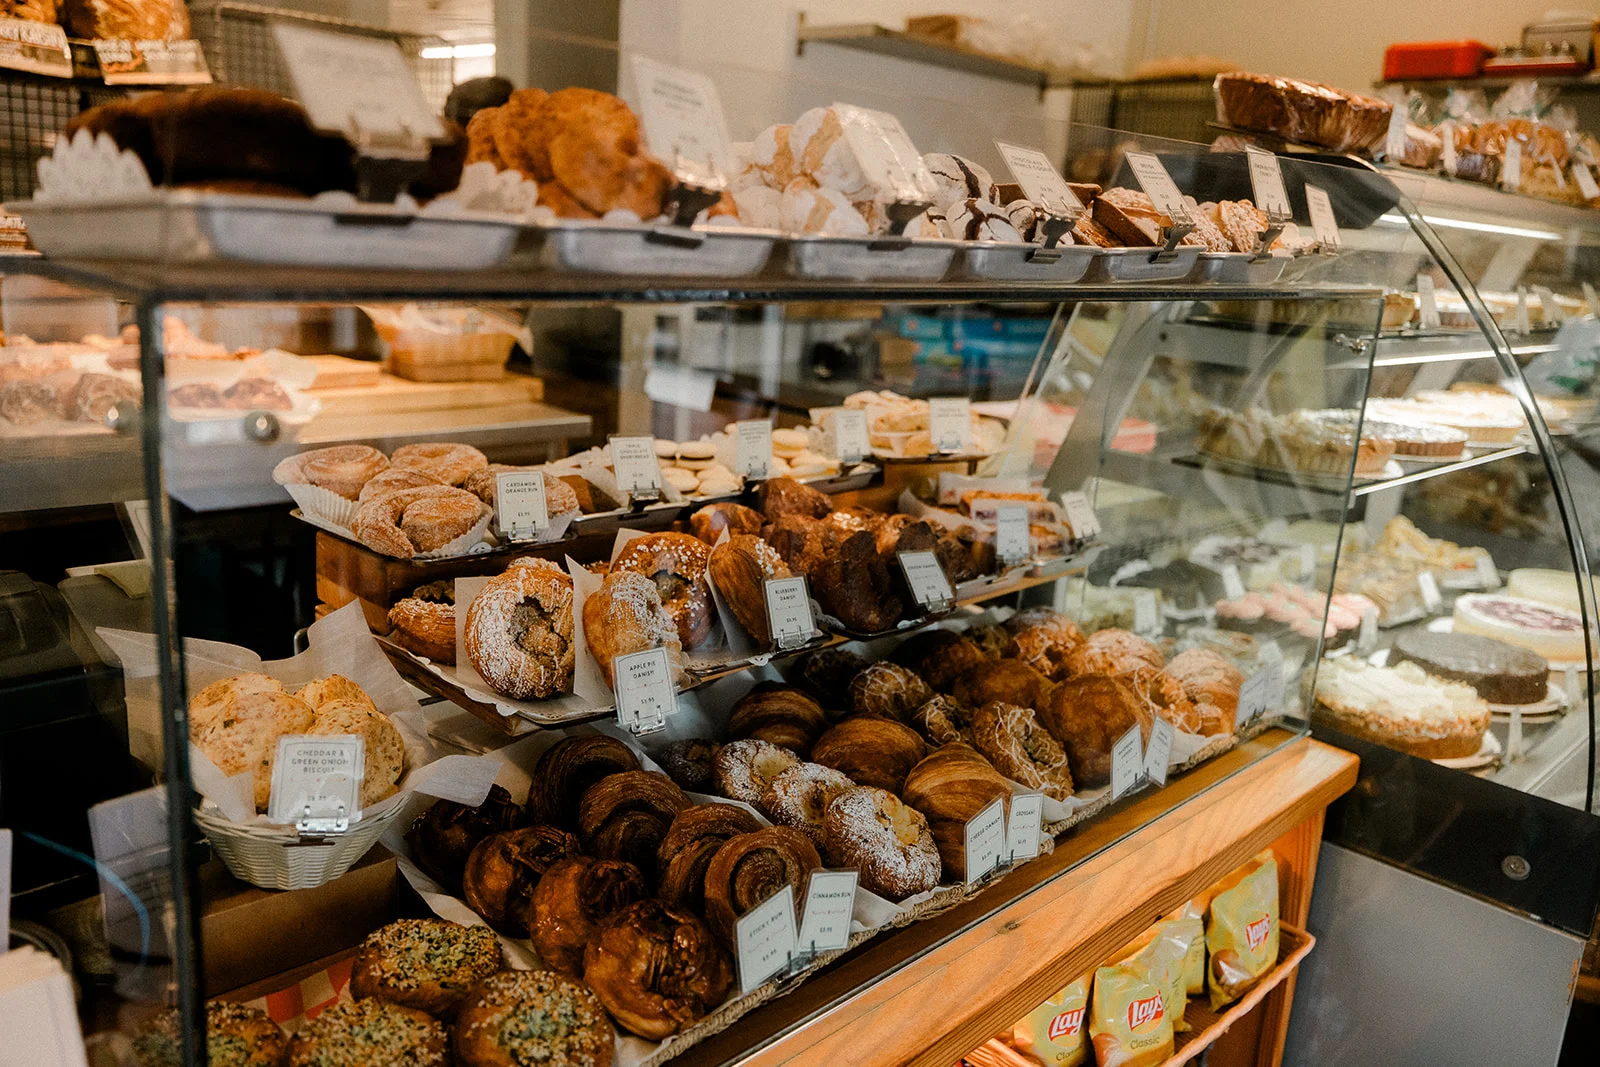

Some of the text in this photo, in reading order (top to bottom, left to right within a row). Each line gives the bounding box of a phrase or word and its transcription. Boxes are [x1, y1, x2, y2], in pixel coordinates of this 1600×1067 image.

[629, 662, 646, 671] APPLE
[633, 670, 655, 679] DANISH
[970, 829, 985, 842] CHEESE
[749, 911, 783, 938] STICKY BUN
[1131, 994, 1164, 1029] Lay's
[1129, 1035, 1160, 1050] Classic
